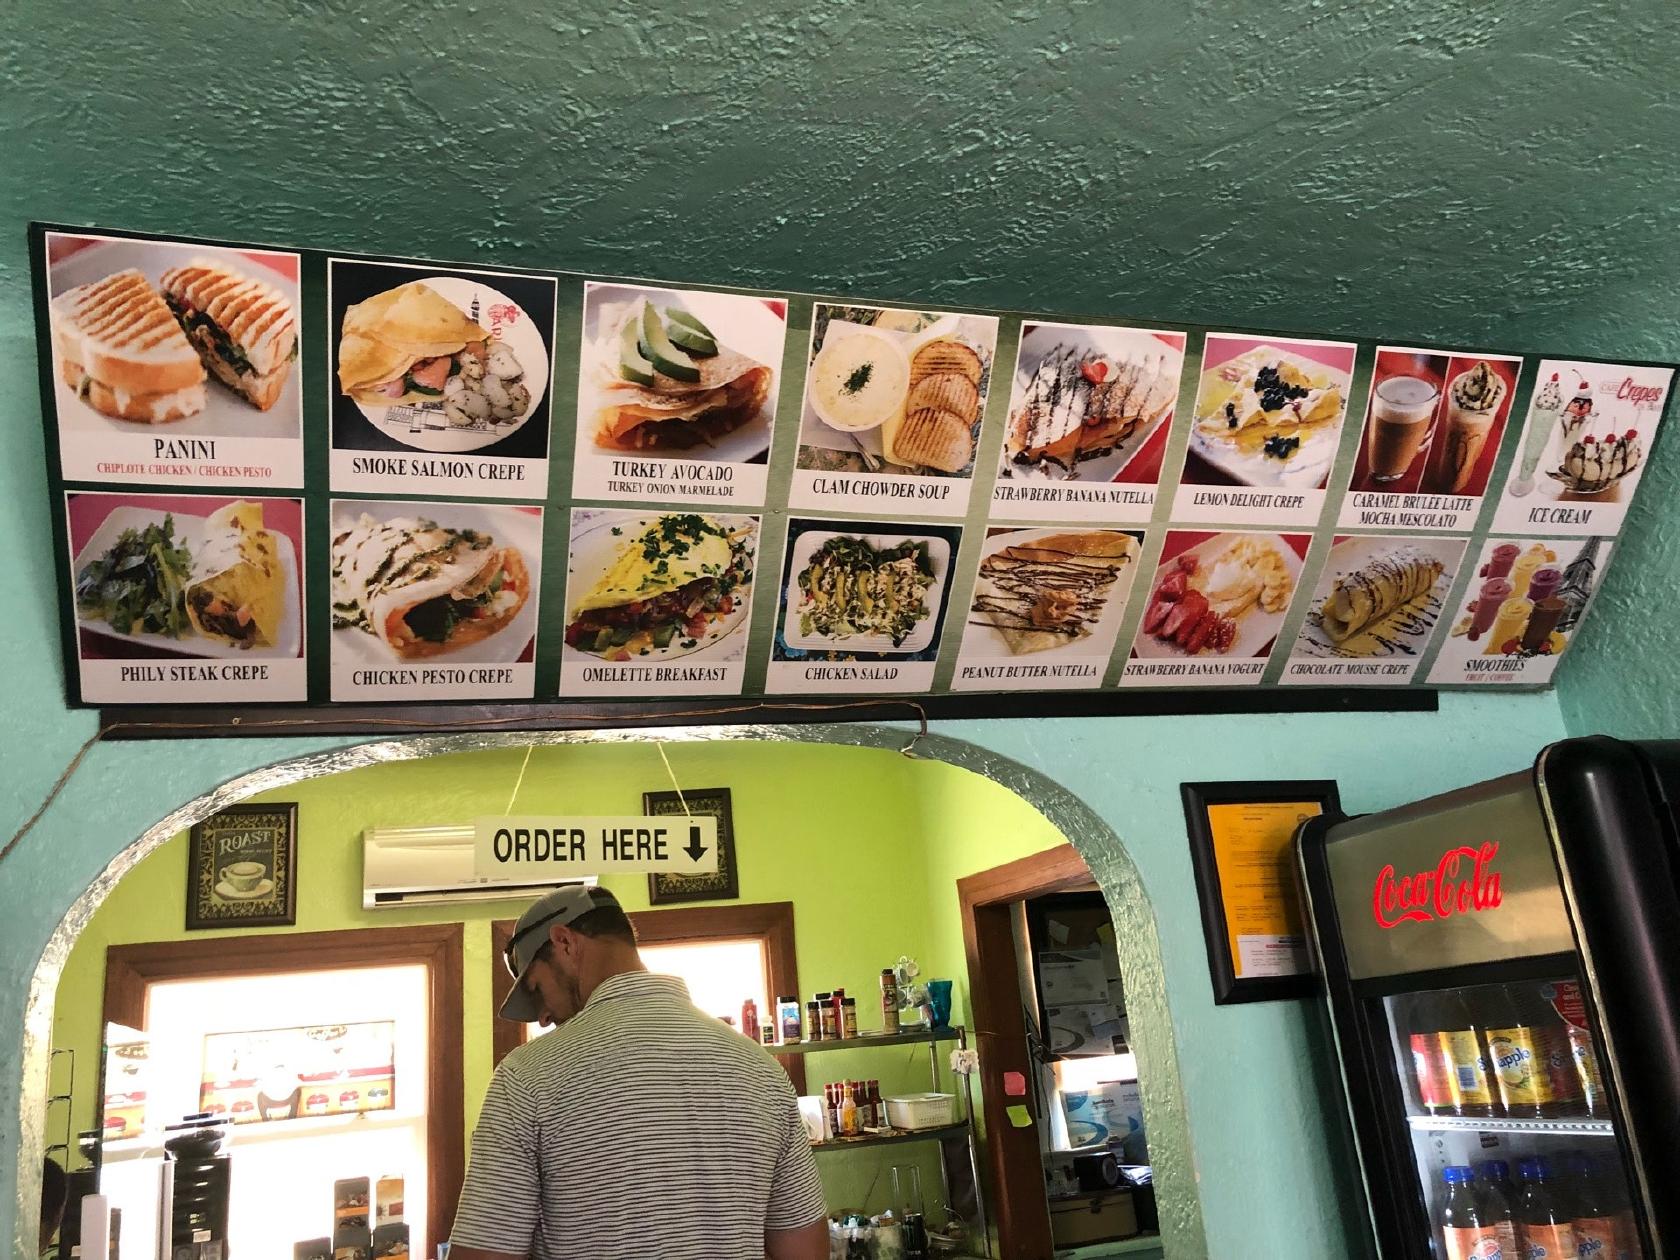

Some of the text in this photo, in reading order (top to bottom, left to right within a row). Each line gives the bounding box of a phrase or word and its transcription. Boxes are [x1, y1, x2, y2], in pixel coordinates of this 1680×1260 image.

[153, 438, 216, 460] PANINI
[97, 462, 145, 475] CHIPLOTE
[149, 464, 192, 475] CHICKEN
[199, 465, 241, 477] CHICKEN
[243, 466, 272, 478] PESTO
[353, 457, 525, 481] SMOKE SALMON CREPE
[612, 460, 733, 482] TURKEY AVOCADO
[608, 480, 735, 497] TURKEY ONION MARMELADE
[812, 478, 950, 500] CLAM CHOWDER SOUP
[993, 486, 1154, 505] STRAWBERRY BANANA NUTELLA
[1193, 492, 1305, 509] LEMON DELIGHT CREPE
[1353, 493, 1401, 508] CARAMEL
[1442, 497, 1474, 511] LATTE
[1359, 511, 1458, 528] MOCHA MESCOLATO
[1528, 507, 1592, 524] ICE CREAM
[121, 665, 269, 682] PHILY STEAK CREPE
[805, 667, 899, 680] CHICKEN SALAD
[961, 664, 1097, 679] PEANUT BUTTER NUTELLA
[1124, 662, 1265, 676] STRAWBERRY BANANA YOGURT
[1290, 664, 1344, 675] CHOCOLATE
[1381, 664, 1410, 675] CREPE
[1463, 659, 1526, 672] SMOOTHIES
[352, 668, 513, 686] CHICKEN PESTO CREPE
[583, 667, 728, 682] OMELETTE BREAKFAST
[219, 830, 271, 856] ROAST
[493, 827, 669, 863] ORDER HERE
